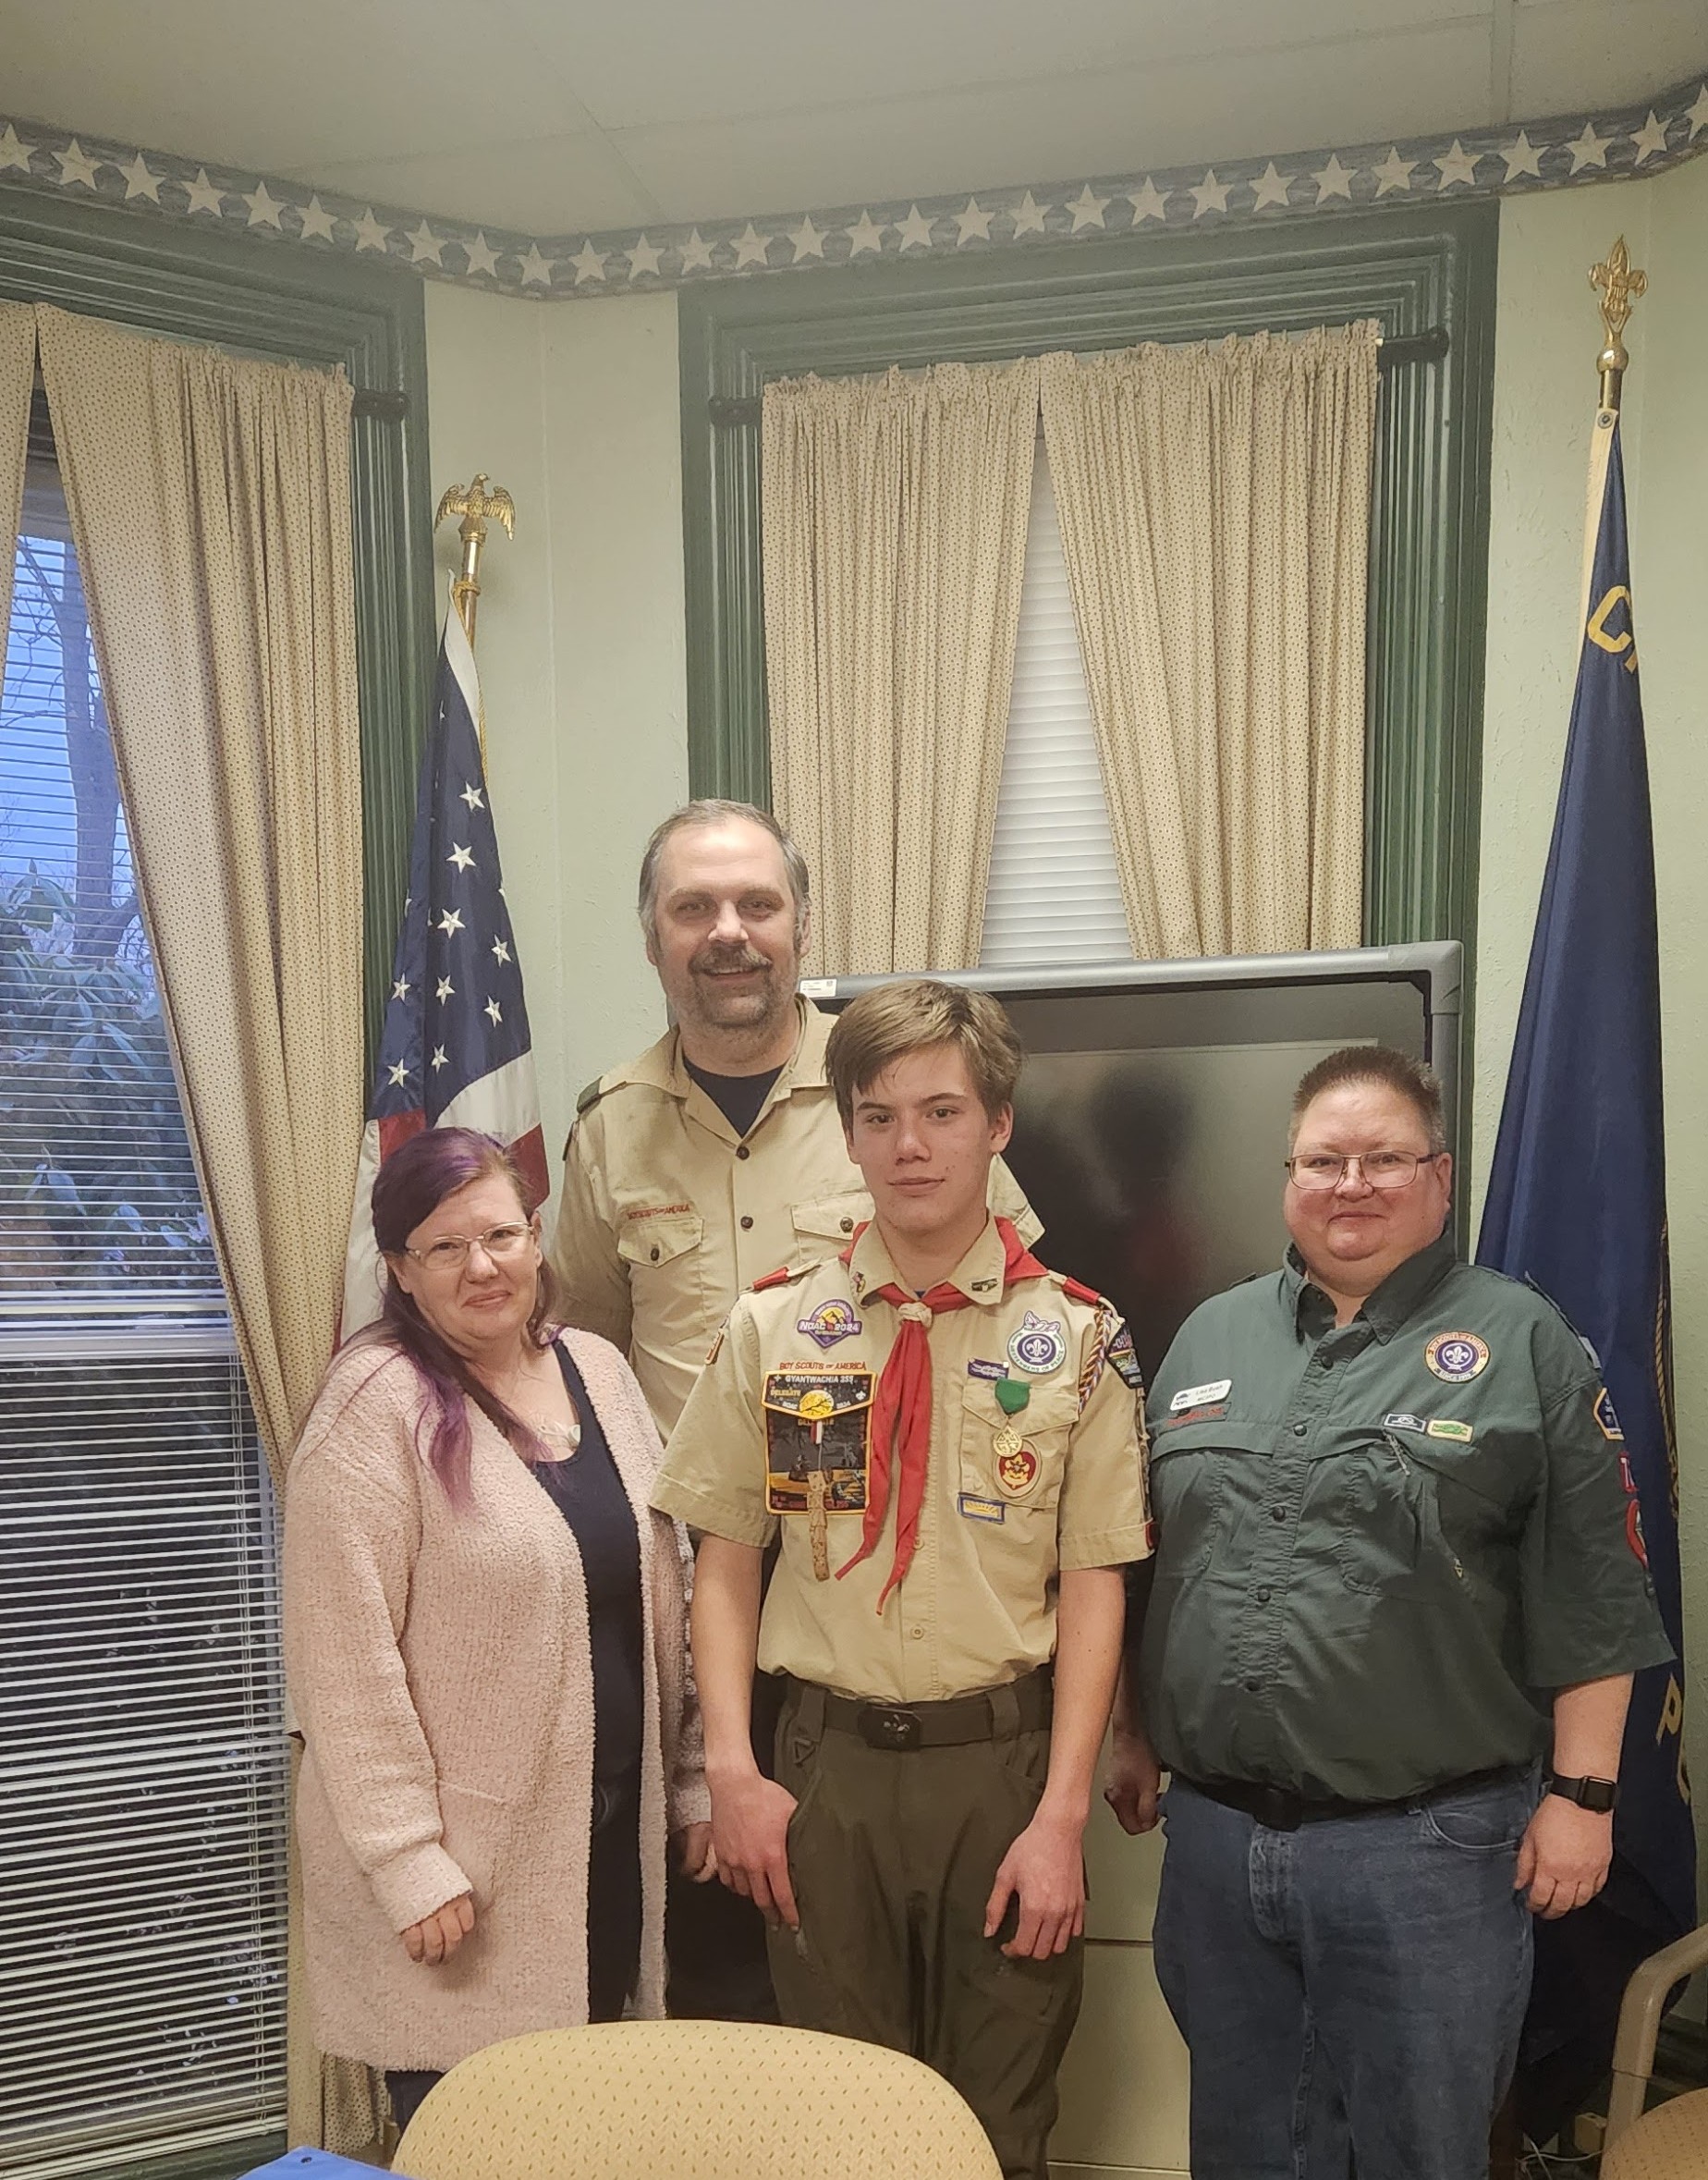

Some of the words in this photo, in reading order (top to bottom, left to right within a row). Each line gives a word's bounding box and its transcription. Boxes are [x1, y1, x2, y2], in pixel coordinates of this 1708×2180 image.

[799, 1321, 826, 1331] NOAC
[835, 1323, 859, 1332] 2024
[779, 1362, 794, 1370] BOY
[795, 1362, 824, 1370] SCOUTS
[835, 1362, 866, 1370] AMERICA
